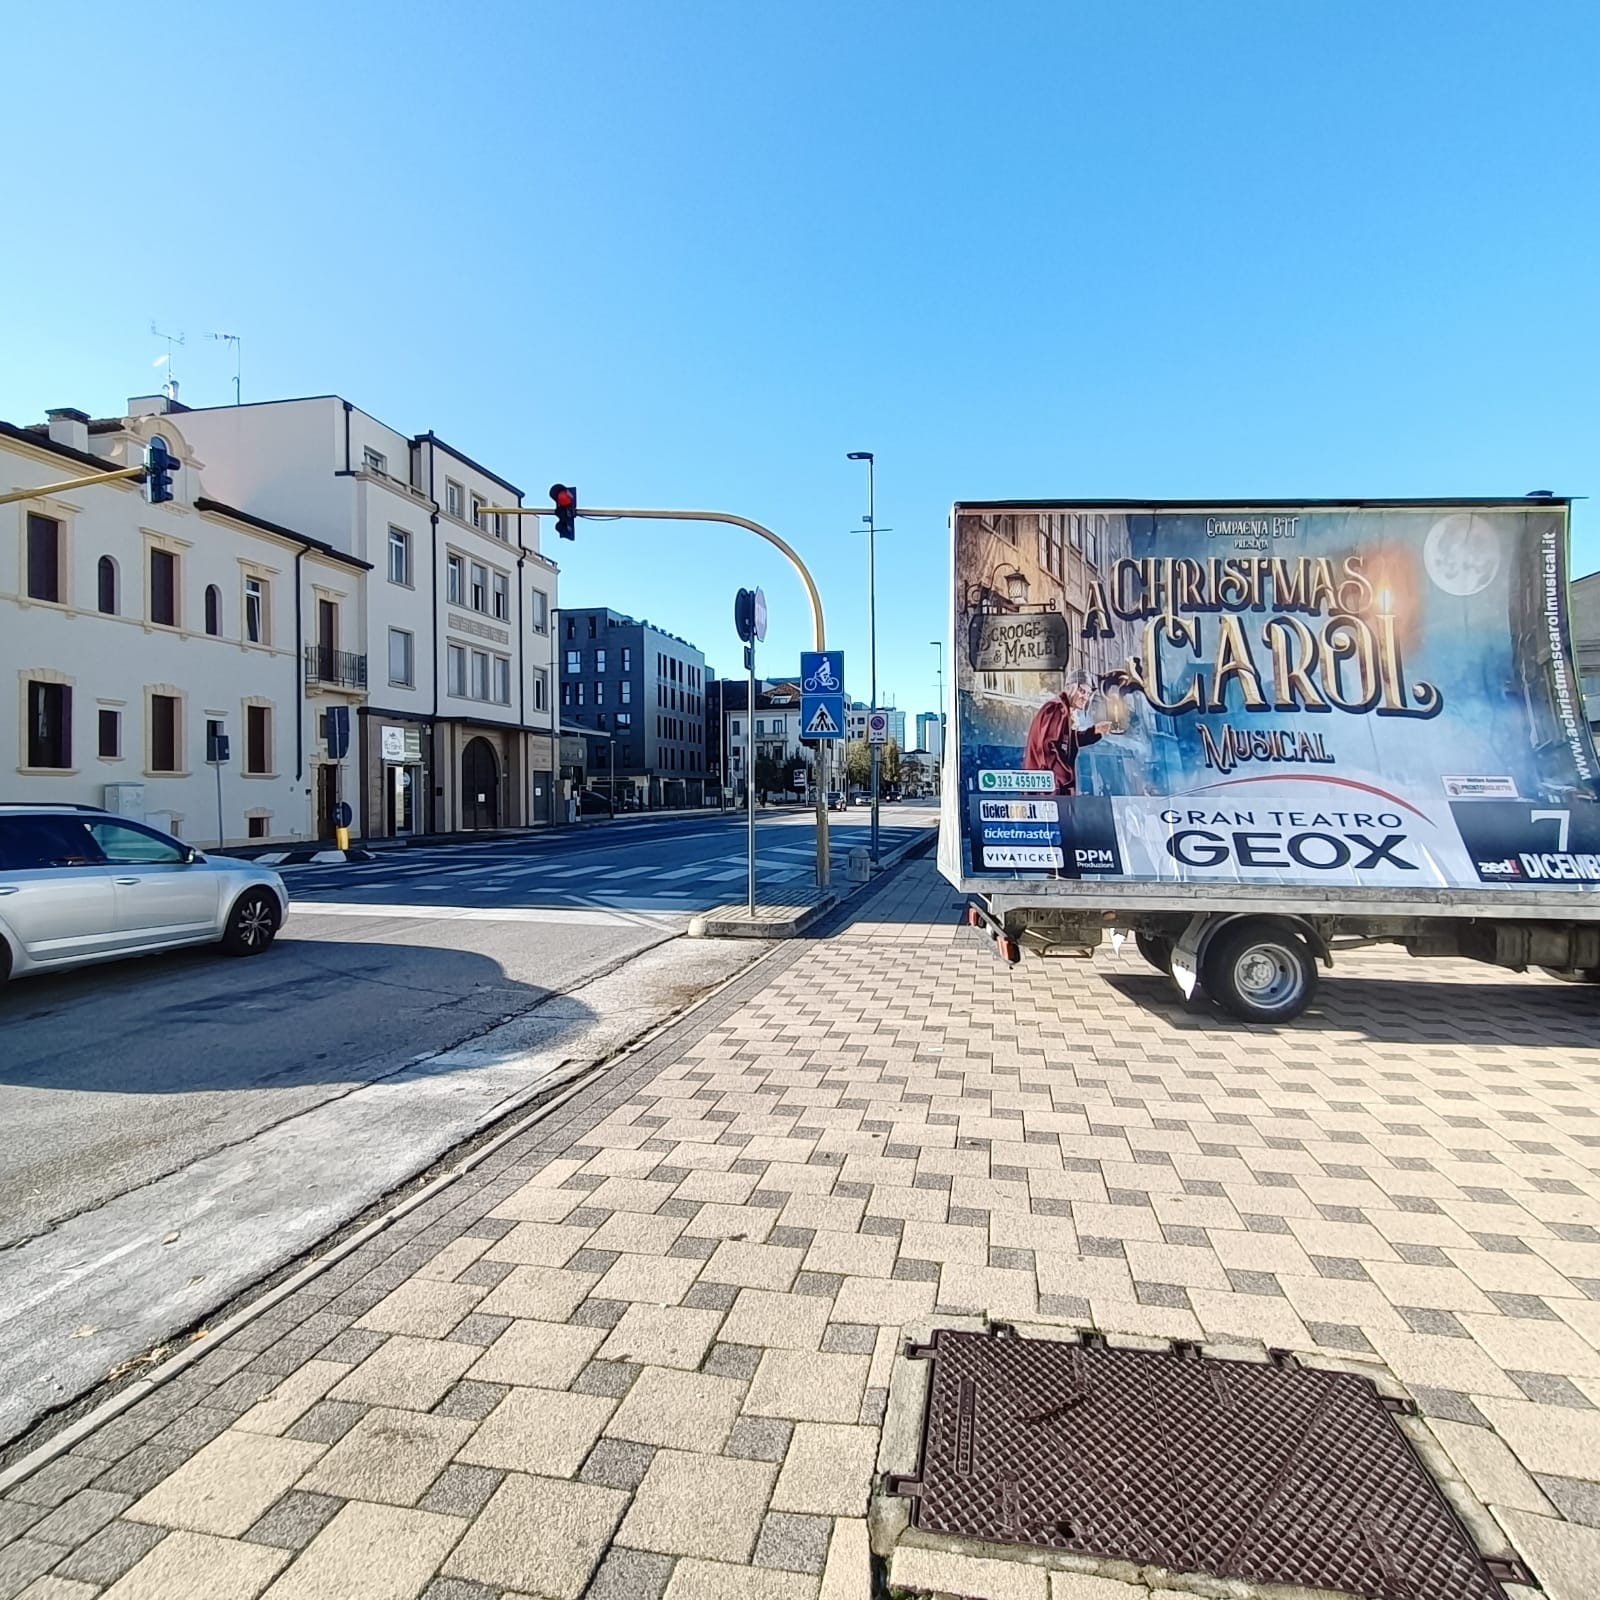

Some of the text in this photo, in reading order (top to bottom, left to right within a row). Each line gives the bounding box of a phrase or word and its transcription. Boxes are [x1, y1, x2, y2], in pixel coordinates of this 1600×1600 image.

[1081, 556, 1374, 639] A CHRISTMAS
[993, 649, 1002, 663] &
[1138, 614, 1443, 720] CAROL
[1541, 531, 1592, 780] www.achristmascarolmusical.it
[1197, 723, 1336, 774] MUSICAL
[997, 775, 1052, 788] 392 4550795
[984, 827, 1055, 840] ticketmaster
[1160, 810, 1403, 829] GRAN TEATRO
[1531, 809, 1570, 852] 7
[986, 853, 1060, 862] VIVATICKET
[1075, 849, 1113, 862] DPM
[1166, 830, 1420, 870] GEOX
